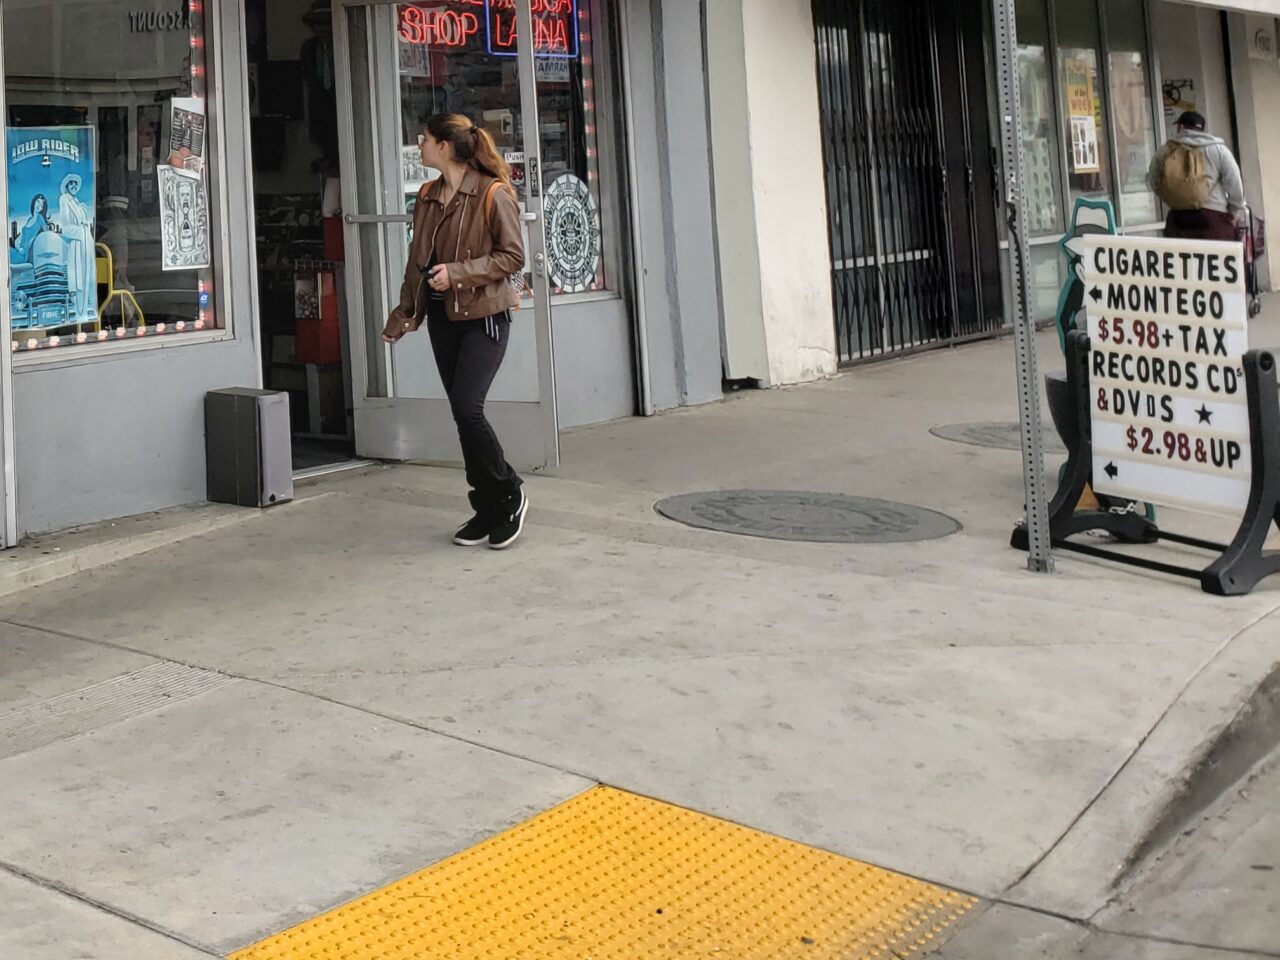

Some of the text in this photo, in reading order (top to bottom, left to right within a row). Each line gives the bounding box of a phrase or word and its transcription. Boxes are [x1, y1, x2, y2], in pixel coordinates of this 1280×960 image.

[402, 7, 478, 46] SHOP
[496, 13, 569, 51] LAINA
[41, 138, 80, 163] RIDER
[530, 159, 538, 189] PUSH
[1107, 283, 1224, 320] MONTEGO
[1093, 350, 1199, 390] RECORDS
